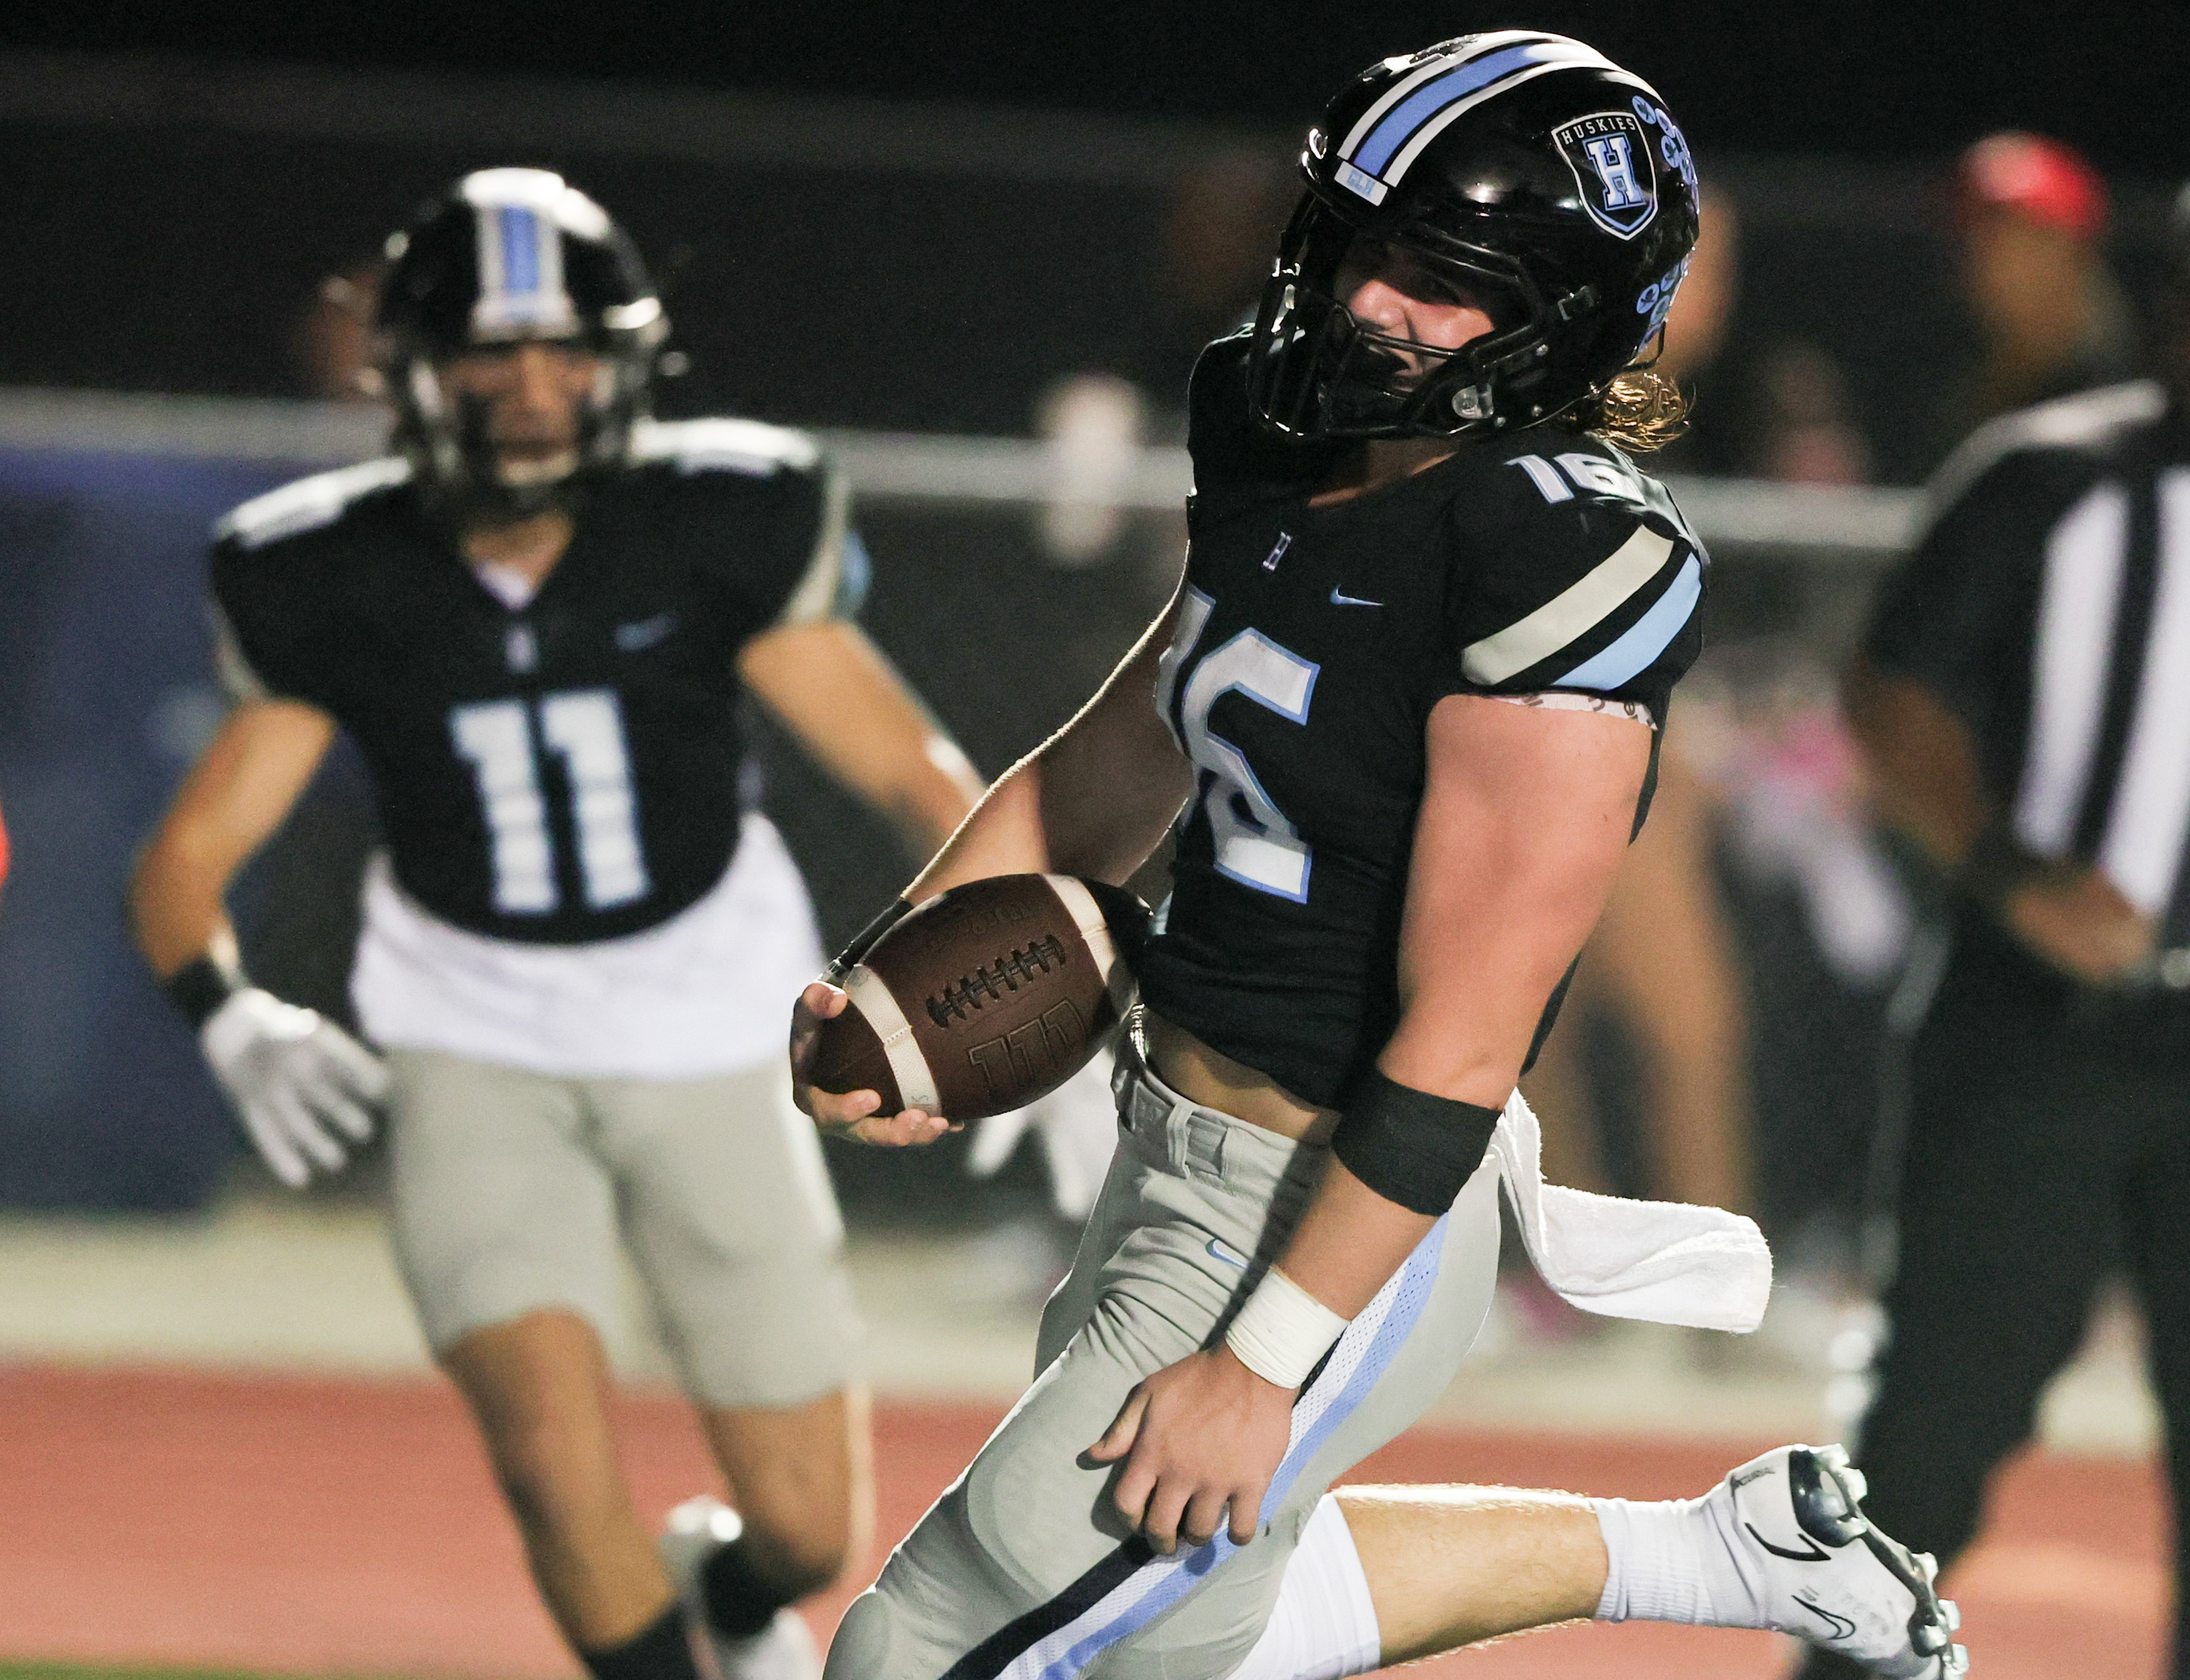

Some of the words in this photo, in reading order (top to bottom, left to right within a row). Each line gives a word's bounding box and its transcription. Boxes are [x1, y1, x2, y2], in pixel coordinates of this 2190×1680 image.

[1561, 117, 1636, 145] HUSKIES
[1582, 132, 1647, 212] H
[1503, 452, 1647, 505] 16
[449, 689, 652, 914] 11
